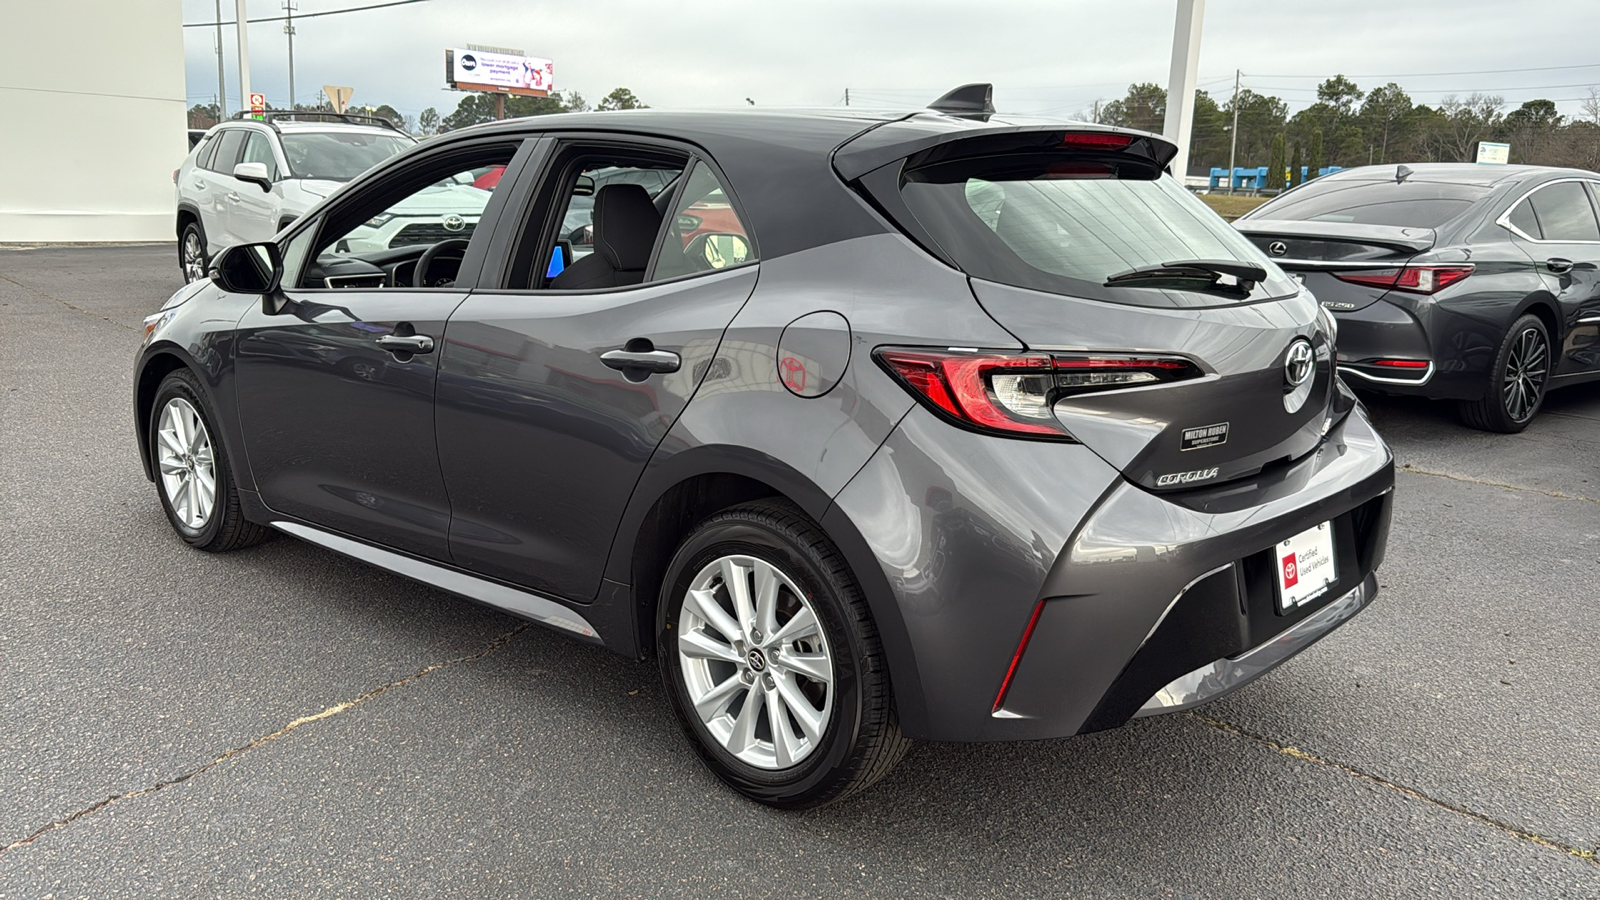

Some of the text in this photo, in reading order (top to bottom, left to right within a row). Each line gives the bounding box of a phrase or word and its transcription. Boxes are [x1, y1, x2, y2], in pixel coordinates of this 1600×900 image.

[1184, 425, 1227, 440] MILTON RUBEN
[1191, 436, 1219, 445] SUPERSTORE
[1156, 467, 1219, 486] COROLLA
[1298, 546, 1318, 563] Certified
[1300, 556, 1329, 576] Used Vehicles
